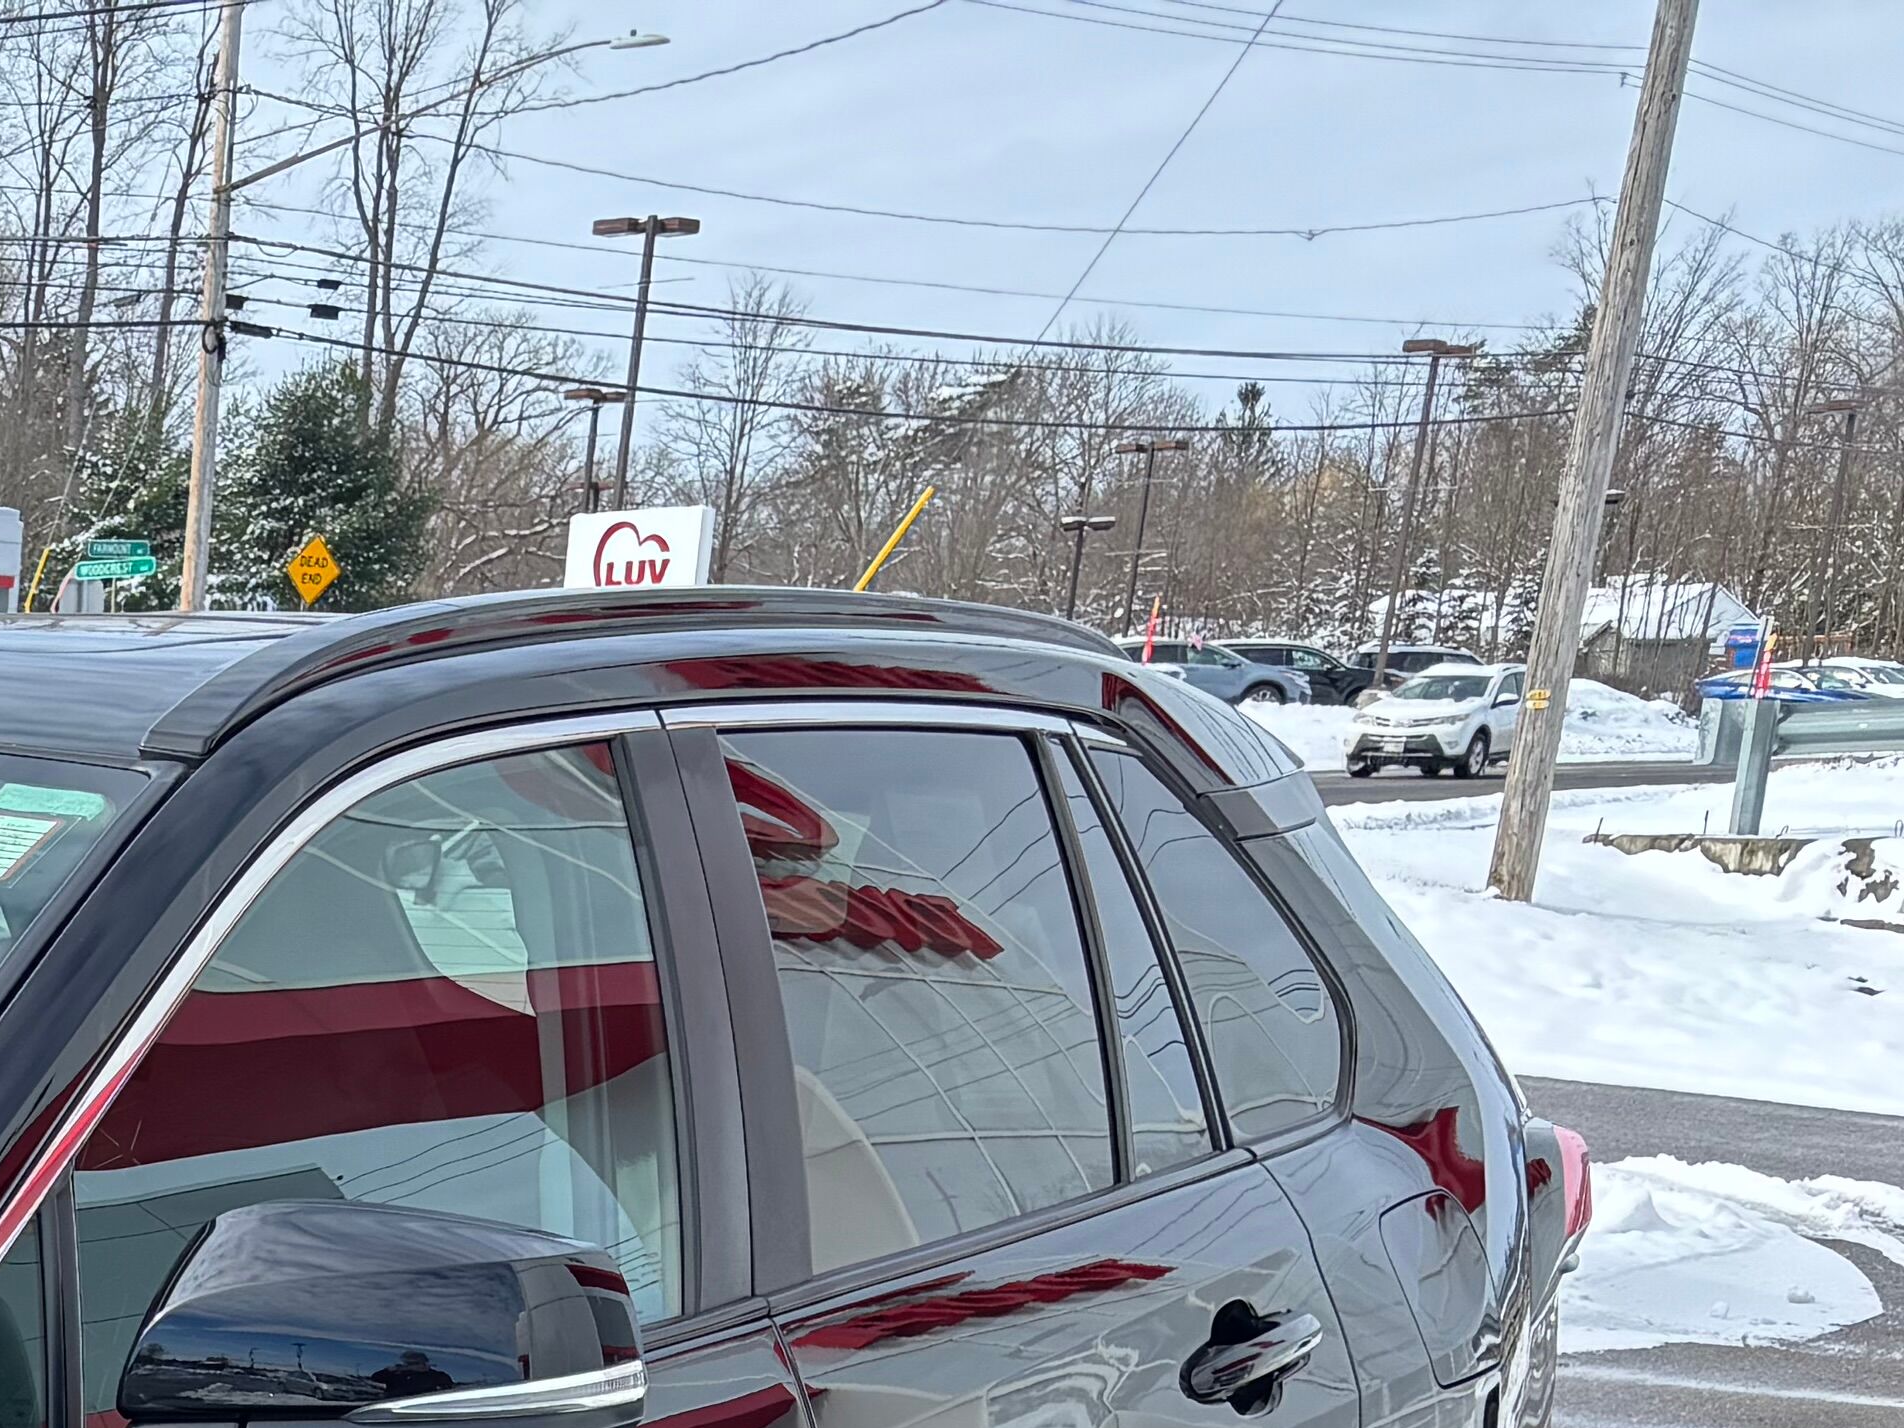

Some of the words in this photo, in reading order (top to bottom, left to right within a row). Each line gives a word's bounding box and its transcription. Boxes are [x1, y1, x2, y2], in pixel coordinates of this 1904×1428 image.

[299, 554, 328, 569] DEAD
[301, 572, 322, 585] END
[605, 558, 671, 586] LUV
